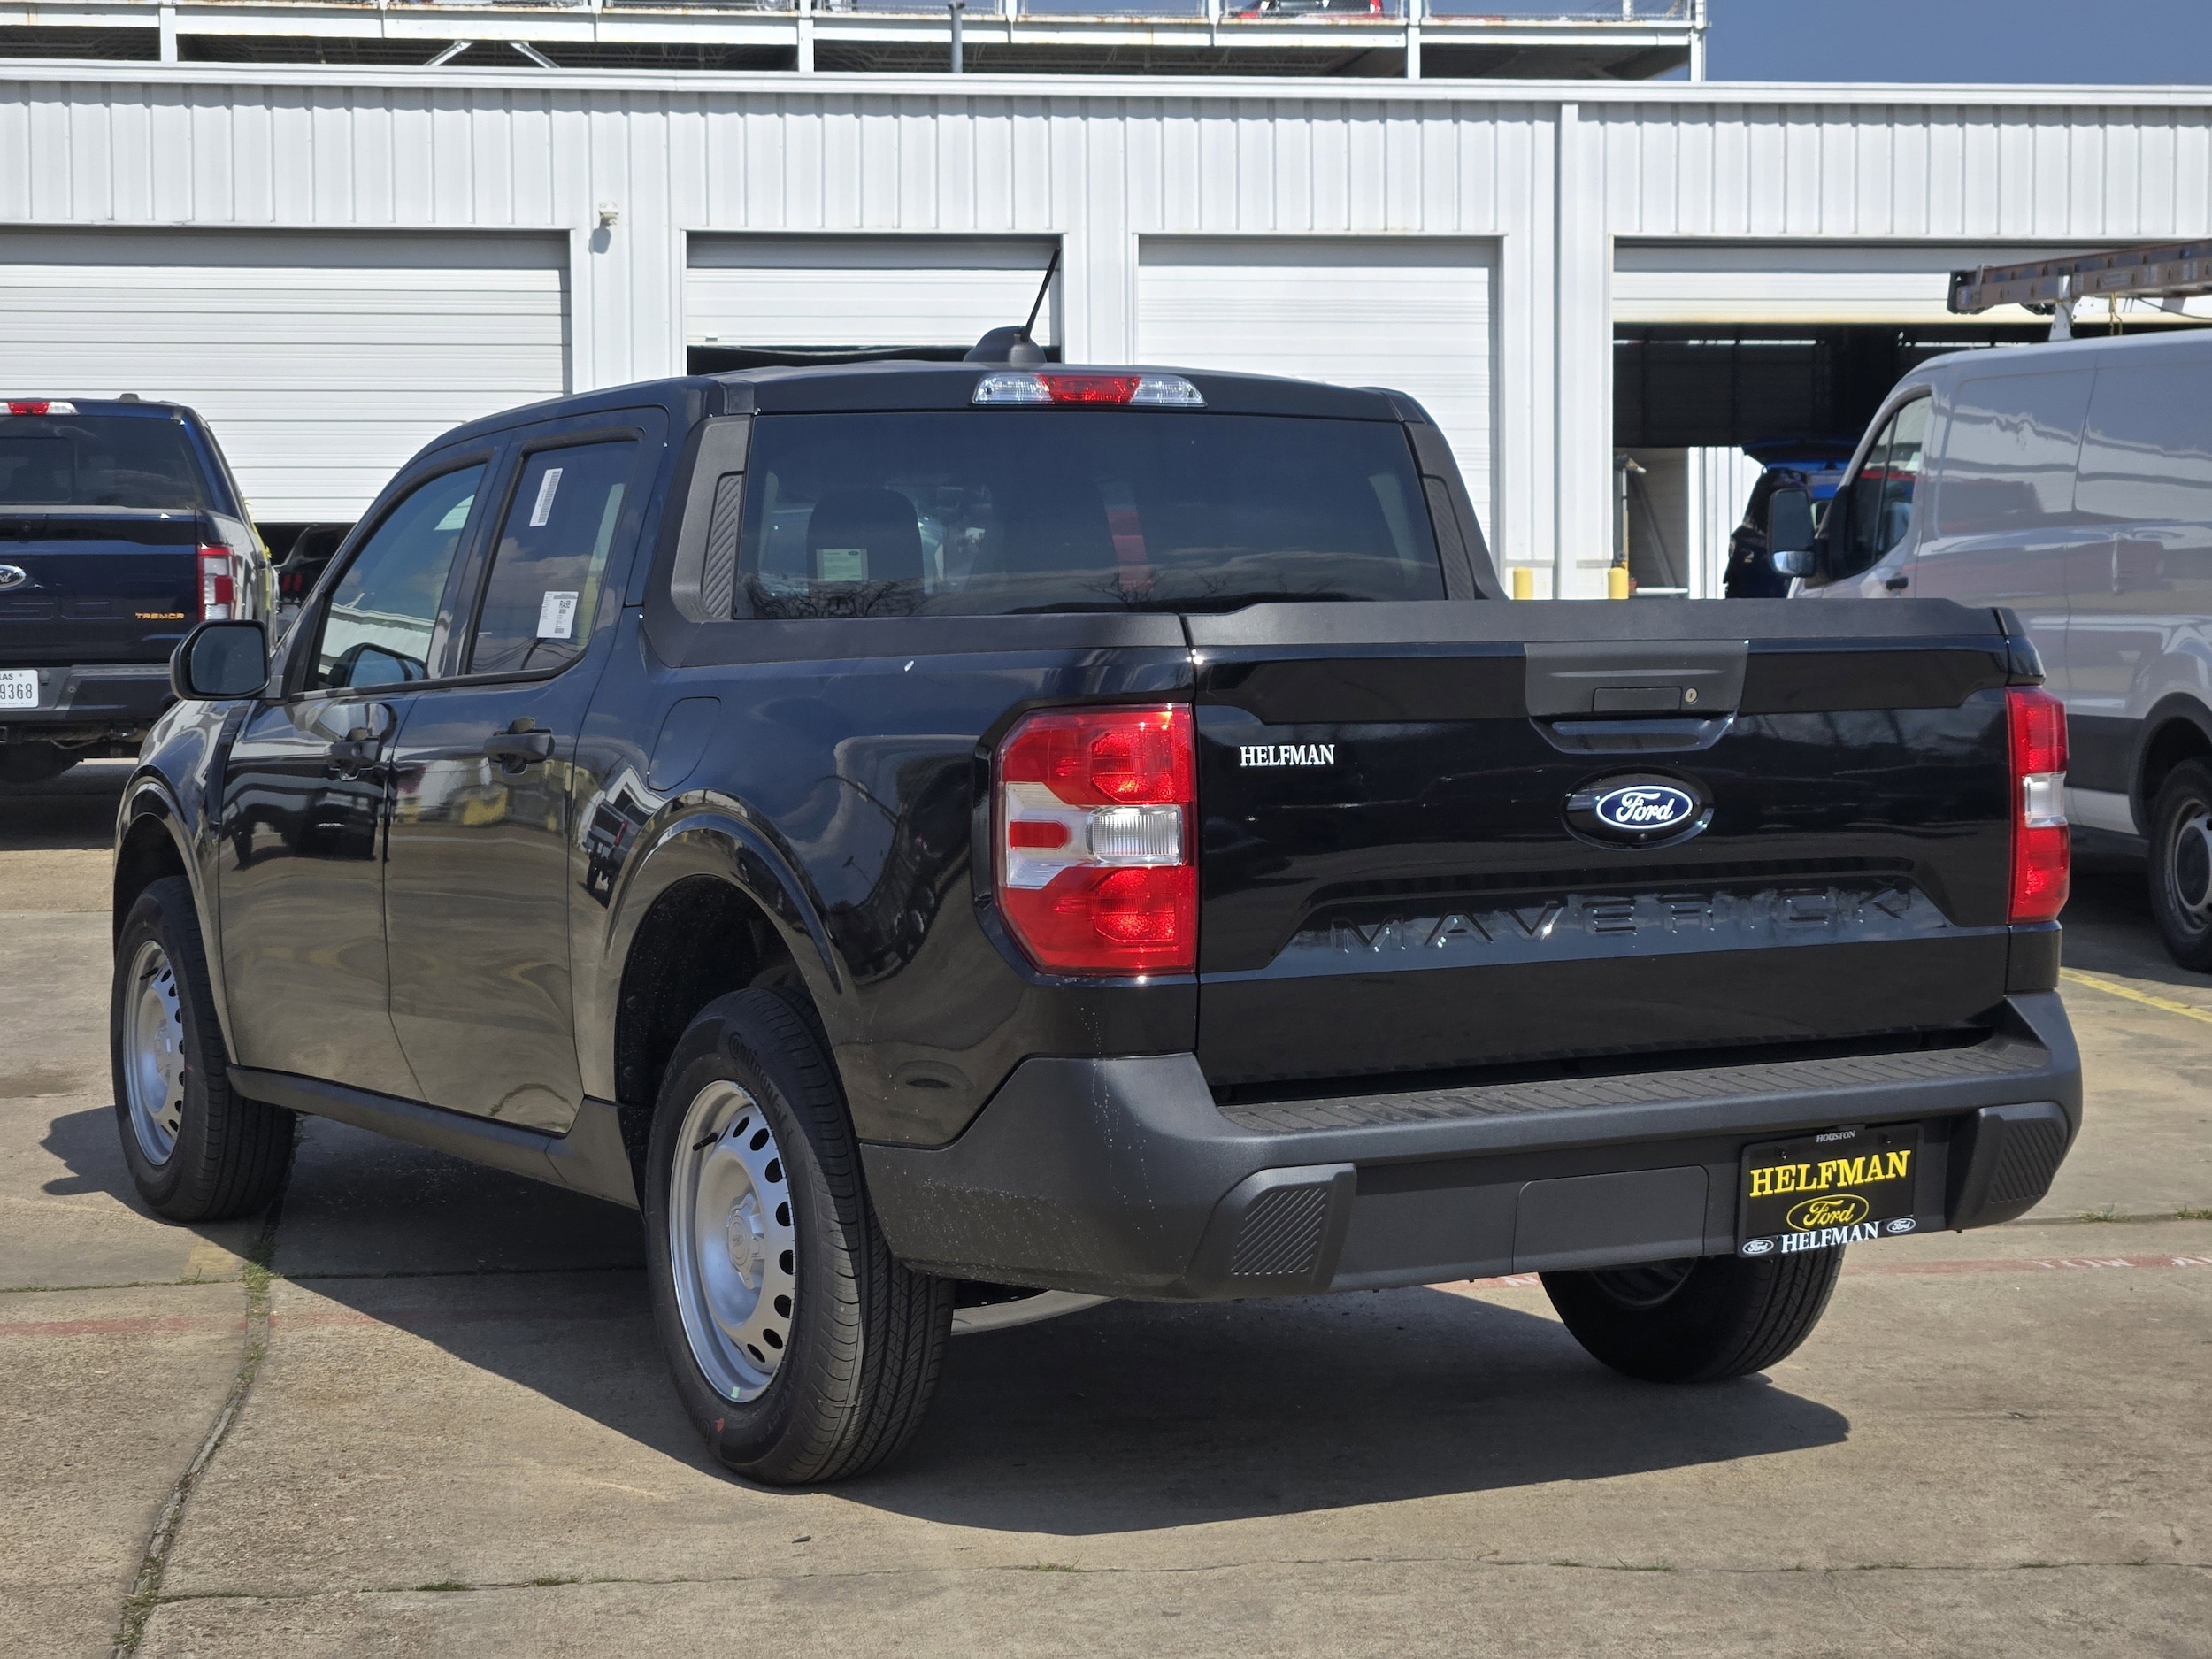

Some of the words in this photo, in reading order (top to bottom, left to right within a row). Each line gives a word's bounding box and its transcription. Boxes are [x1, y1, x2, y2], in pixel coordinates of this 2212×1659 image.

[1240, 744, 1335, 767] HELFMAN
[1616, 792, 1675, 823] Ford
[1330, 887, 1912, 954] MAVERICK
[1816, 1130, 1856, 1143] HOUSTON
[1749, 1150, 1911, 1197] HELFMAN
[1802, 1199, 1856, 1226] Ford
[1781, 1221, 1880, 1253] HELFMAN
